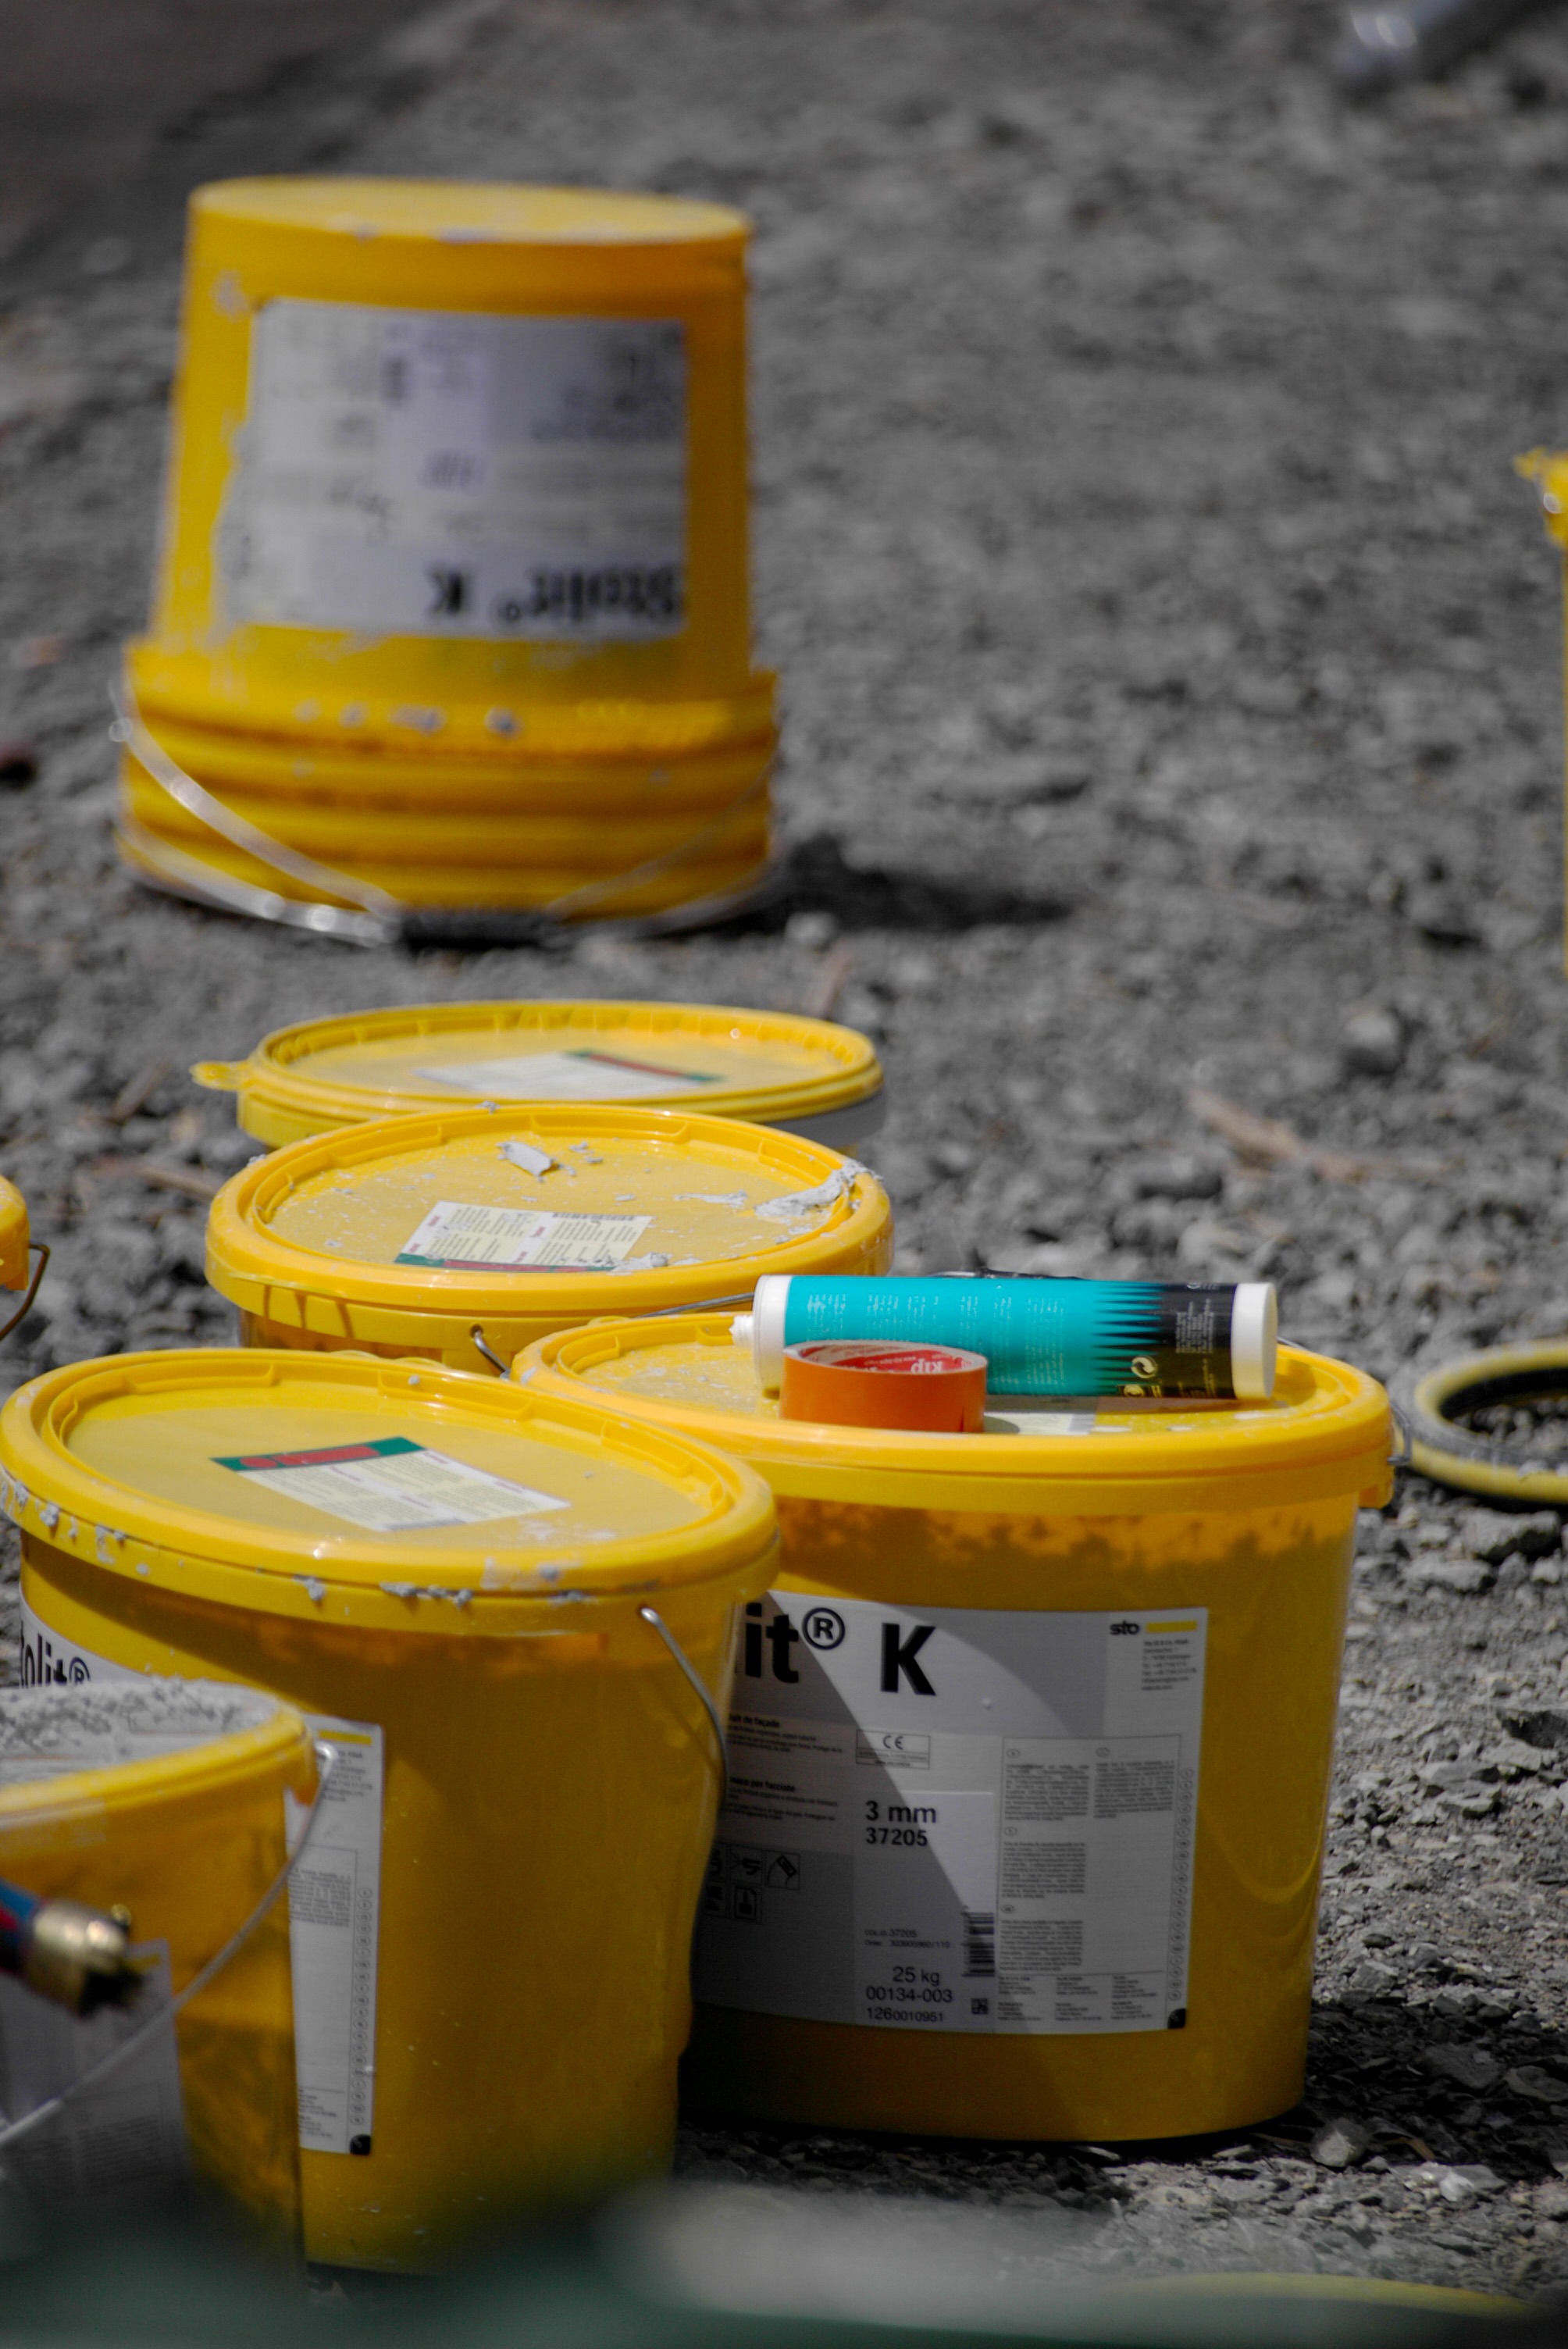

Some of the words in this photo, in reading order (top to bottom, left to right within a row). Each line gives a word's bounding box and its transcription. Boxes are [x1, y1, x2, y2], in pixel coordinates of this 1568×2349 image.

[426, 567, 475, 617] K
[1110, 1620, 1141, 1637] sto
[880, 1622, 937, 1696] K
[882, 1734, 904, 1751] CE
[864, 1798, 879, 1822] 3
[888, 1805, 937, 1823] mm
[864, 1827, 928, 1847] 37205
[893, 1966, 916, 1984] 25
[921, 1968, 940, 1987] kg
[865, 1984, 953, 2004] 00134-003
